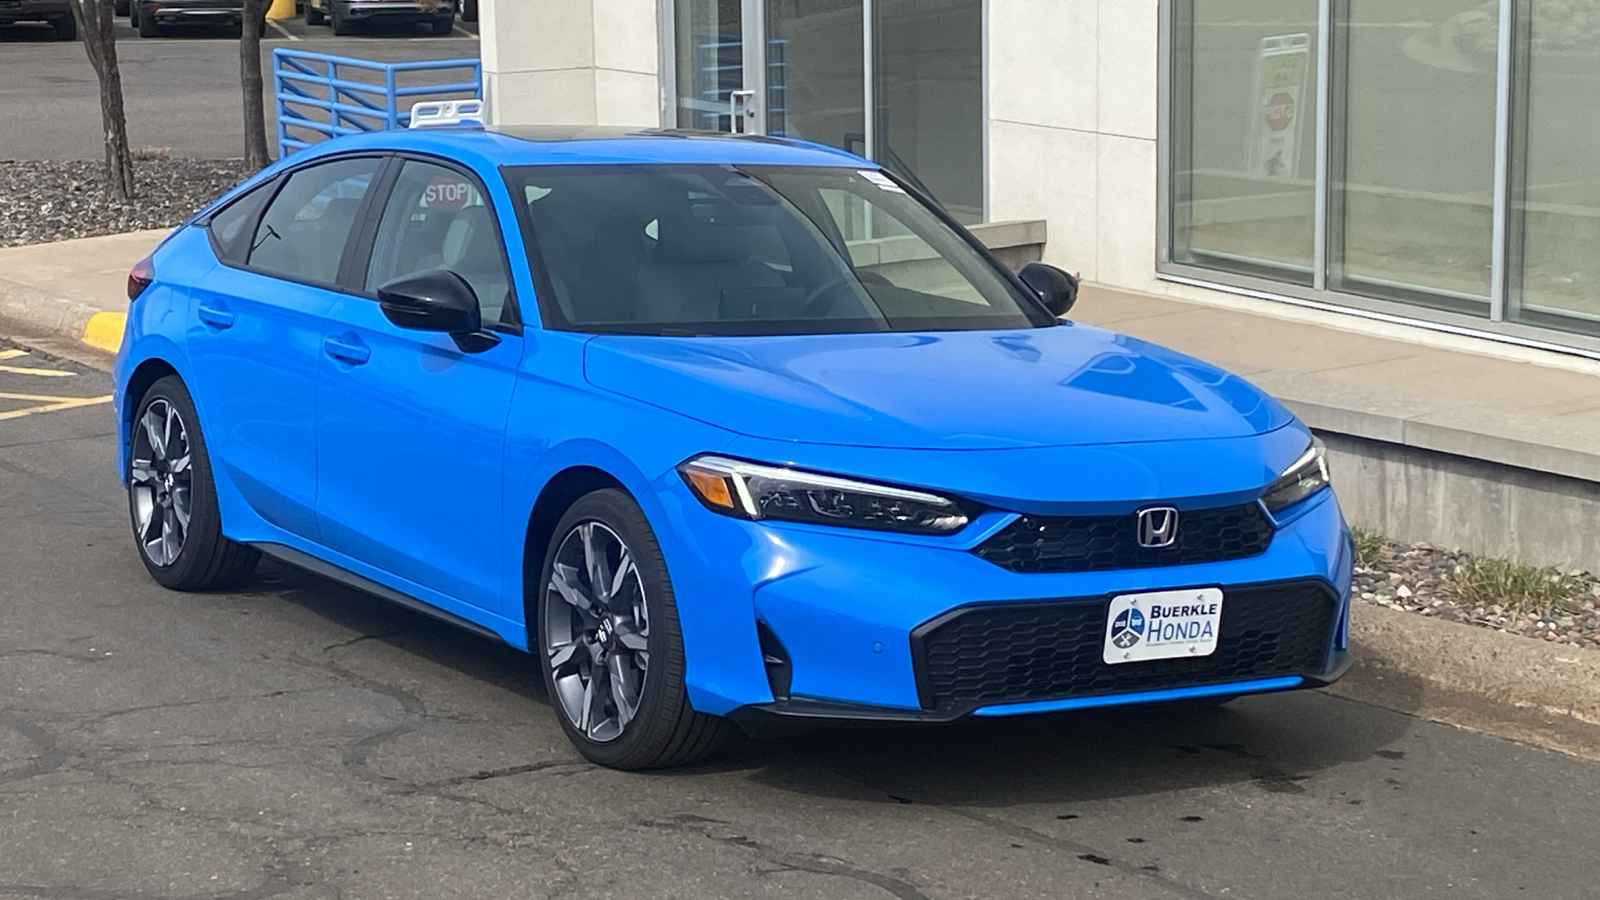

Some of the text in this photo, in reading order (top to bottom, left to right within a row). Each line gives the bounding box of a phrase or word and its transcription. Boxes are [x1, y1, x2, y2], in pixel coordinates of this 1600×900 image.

[426, 183, 467, 202] STOP
[1150, 603, 1218, 619] BUERKLE
[1147, 619, 1213, 642] HONDA
